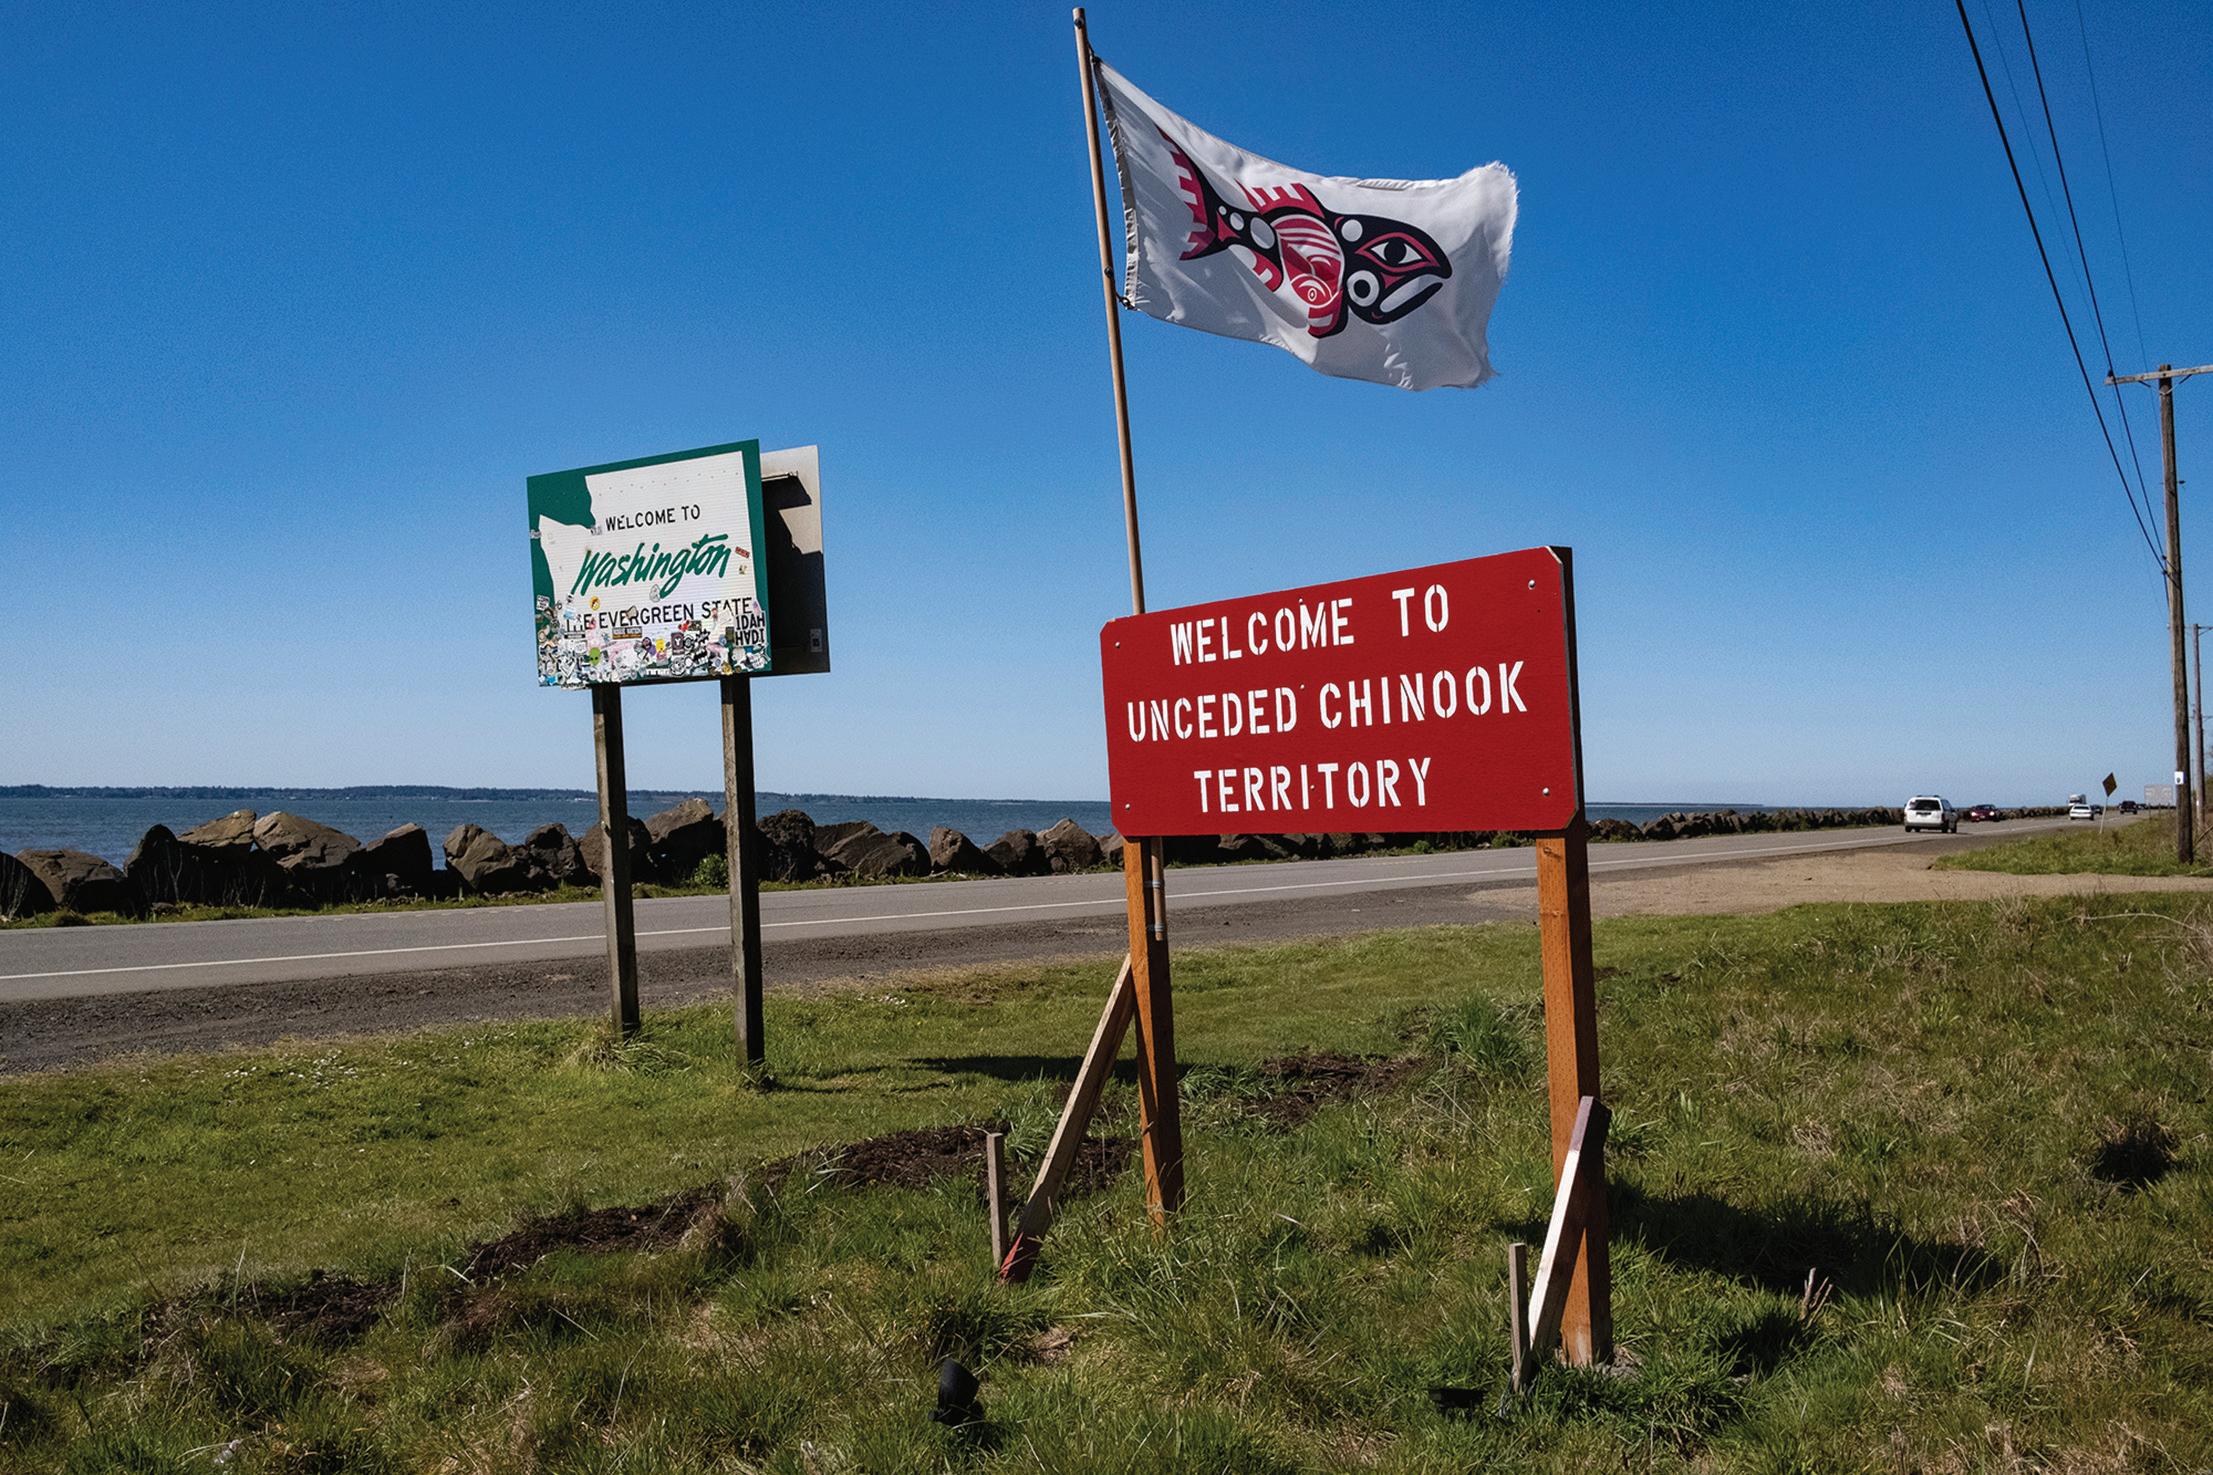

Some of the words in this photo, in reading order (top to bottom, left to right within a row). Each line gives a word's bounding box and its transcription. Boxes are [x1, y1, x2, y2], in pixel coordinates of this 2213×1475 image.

[605, 508, 676, 531] WELCOME
[681, 504, 701, 521] TO
[570, 533, 732, 599] Washington
[598, 604, 694, 629] EVERGREEN
[735, 612, 766, 630] IDAH
[1170, 597, 1355, 666] WELCOME
[1391, 583, 1449, 638] TO
[1126, 686, 1297, 743] UNCEDED
[1318, 660, 1528, 730] CHINOOK
[1193, 756, 1432, 813] TERRITORY
